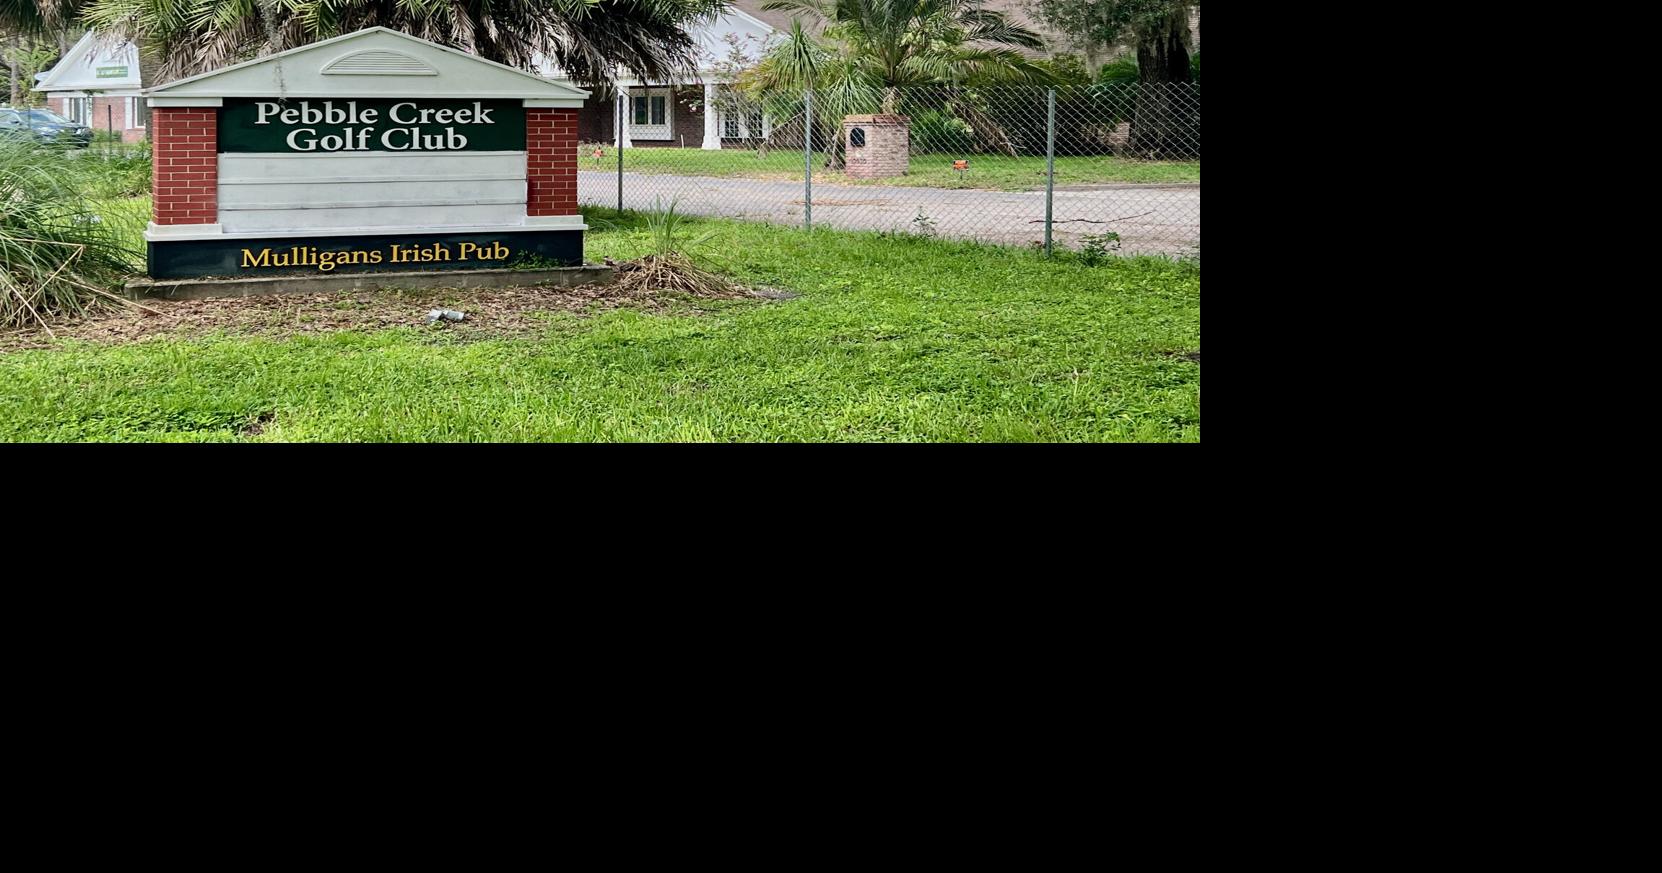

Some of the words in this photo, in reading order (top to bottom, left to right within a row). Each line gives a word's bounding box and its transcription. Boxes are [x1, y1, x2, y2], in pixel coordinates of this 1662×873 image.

[254, 101, 378, 124] Pebble
[389, 102, 495, 124] Creek
[286, 127, 375, 150] Golf
[381, 127, 468, 150] Club
[241, 246, 382, 271] Mulligans
[390, 243, 451, 263] Irish
[458, 241, 510, 260] Pub
